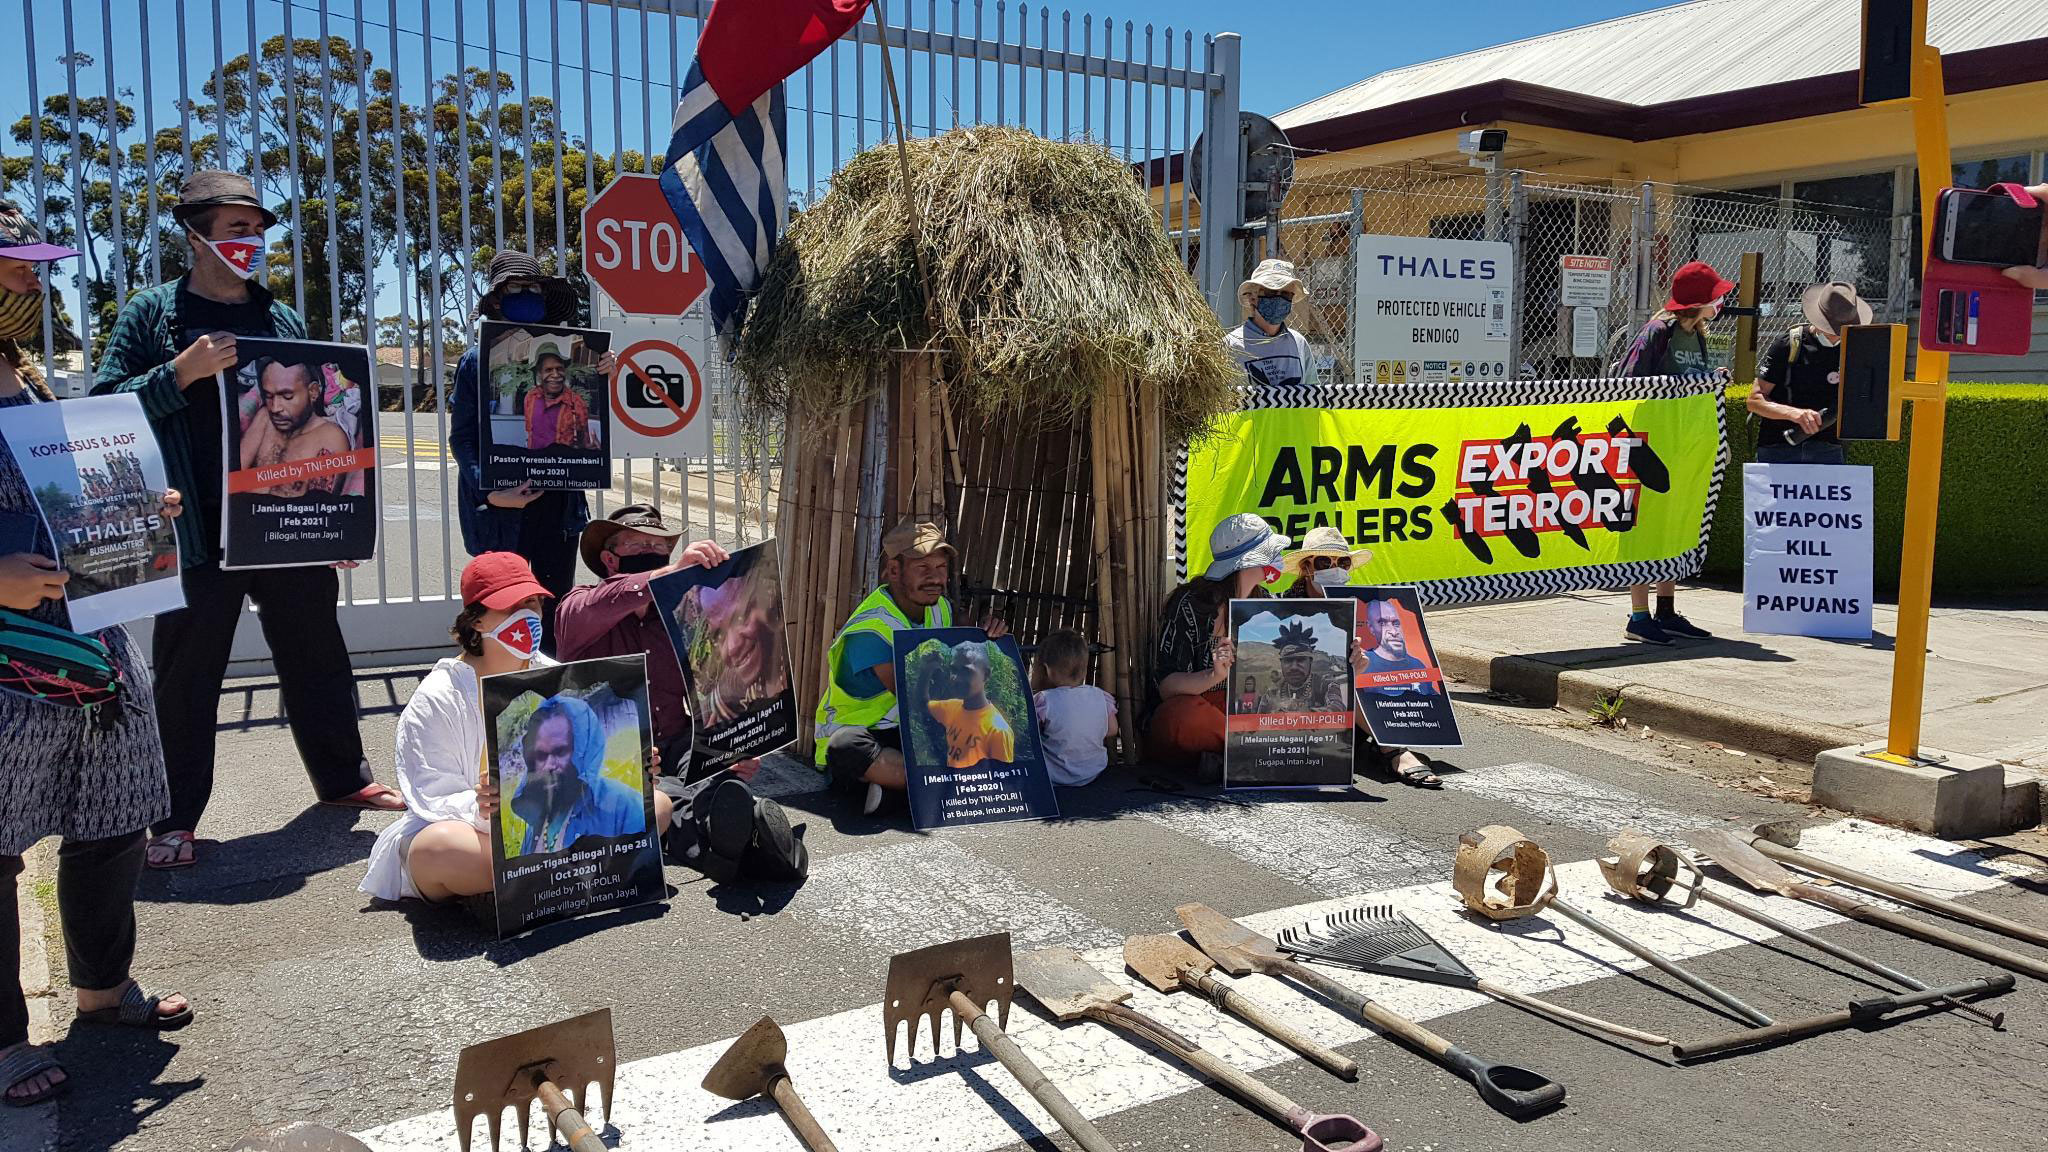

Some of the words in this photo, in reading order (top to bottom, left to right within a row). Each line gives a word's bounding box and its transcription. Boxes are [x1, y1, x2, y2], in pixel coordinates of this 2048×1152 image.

[1377, 255, 1496, 280] THALES
[1568, 258, 1584, 268] SITE
[1584, 259, 1608, 269] NOTICE
[1377, 300, 1440, 317] PROTECTED
[1443, 301, 1486, 318] VEHICLE
[1412, 328, 1460, 344] BENDIGO
[1424, 362, 1446, 370] NOTICE
[1362, 374, 1372, 384] 15
[29, 438, 100, 458] KOPASSUS
[113, 432, 136, 446] ADF
[494, 456, 520, 464] Pastor
[520, 456, 556, 464] Yeremiah
[558, 457, 600, 465] Zanambani
[1460, 437, 1643, 483] EXPORT
[256, 466, 287, 482] Killed
[290, 466, 302, 478] by
[304, 455, 356, 474] TNI-POLRI
[530, 468, 546, 476] Nov
[546, 468, 566, 476] 2020
[1257, 443, 1440, 508] ARMS
[497, 479, 518, 487] Killed
[530, 479, 564, 487] TNI-POLRI
[568, 480, 597, 488] Hitadipa
[104, 494, 122, 503] WEST
[1770, 484, 1852, 502] THALES
[256, 504, 285, 513] Janius
[286, 504, 314, 514] Bagau
[320, 504, 337, 514] Age
[339, 504, 349, 512] 17
[1458, 488, 1636, 534] TERROR!
[284, 517, 300, 526] Feb
[302, 517, 324, 526] 2021
[1754, 511, 1863, 530] WEAPONS
[68, 514, 161, 544] THALES
[300, 531, 321, 540] Intan
[322, 531, 339, 541] Jaya
[89, 538, 145, 557] BUSHMASTERS
[1786, 540, 1832, 556] KILL
[1779, 568, 1838, 585] WEST
[1756, 594, 1860, 614] PAPUANS
[1373, 674, 1389, 682] Killed
[1390, 674, 1398, 682] by
[760, 708, 772, 718] Age
[772, 702, 780, 711] 17
[1396, 710, 1406, 718] Feb
[1260, 717, 1284, 726] Killed
[1286, 716, 1298, 726] by
[1300, 715, 1346, 725] TNI-POLRI
[733, 734, 746, 745] Nov
[747, 724, 763, 738] 2020
[1244, 735, 1278, 743] Melanius
[1308, 735, 1323, 743] Age
[705, 755, 724, 766] Killed
[724, 750, 734, 759] by
[734, 736, 764, 755] TNI-POLRI
[1272, 746, 1286, 754] Feb
[1287, 746, 1305, 754] 2021
[1305, 758, 1320, 766] Jaya
[928, 774, 952, 784] Melki
[953, 772, 988, 784] Tigapau
[993, 770, 1010, 779] Age
[1011, 768, 1021, 776] 11
[960, 784, 976, 793] Feb
[977, 783, 999, 792] 2020
[946, 797, 967, 807] Killed
[968, 796, 979, 806] by
[980, 792, 1018, 804] TNI-POLRI
[956, 808, 985, 818] Bulapa,
[985, 805, 1006, 814] Intan
[1007, 804, 1025, 814] Jaya
[614, 842, 633, 854] Age
[635, 838, 648, 849] 28
[555, 871, 572, 882] Oct
[573, 864, 597, 878] 2020
[538, 888, 562, 901] Killed
[562, 885, 574, 896] by
[575, 874, 620, 891] TNI-POLRI
[526, 912, 534, 921] at
[535, 906, 556, 919] Jalae
[557, 897, 589, 912] village,
[590, 893, 614, 904] Intan
